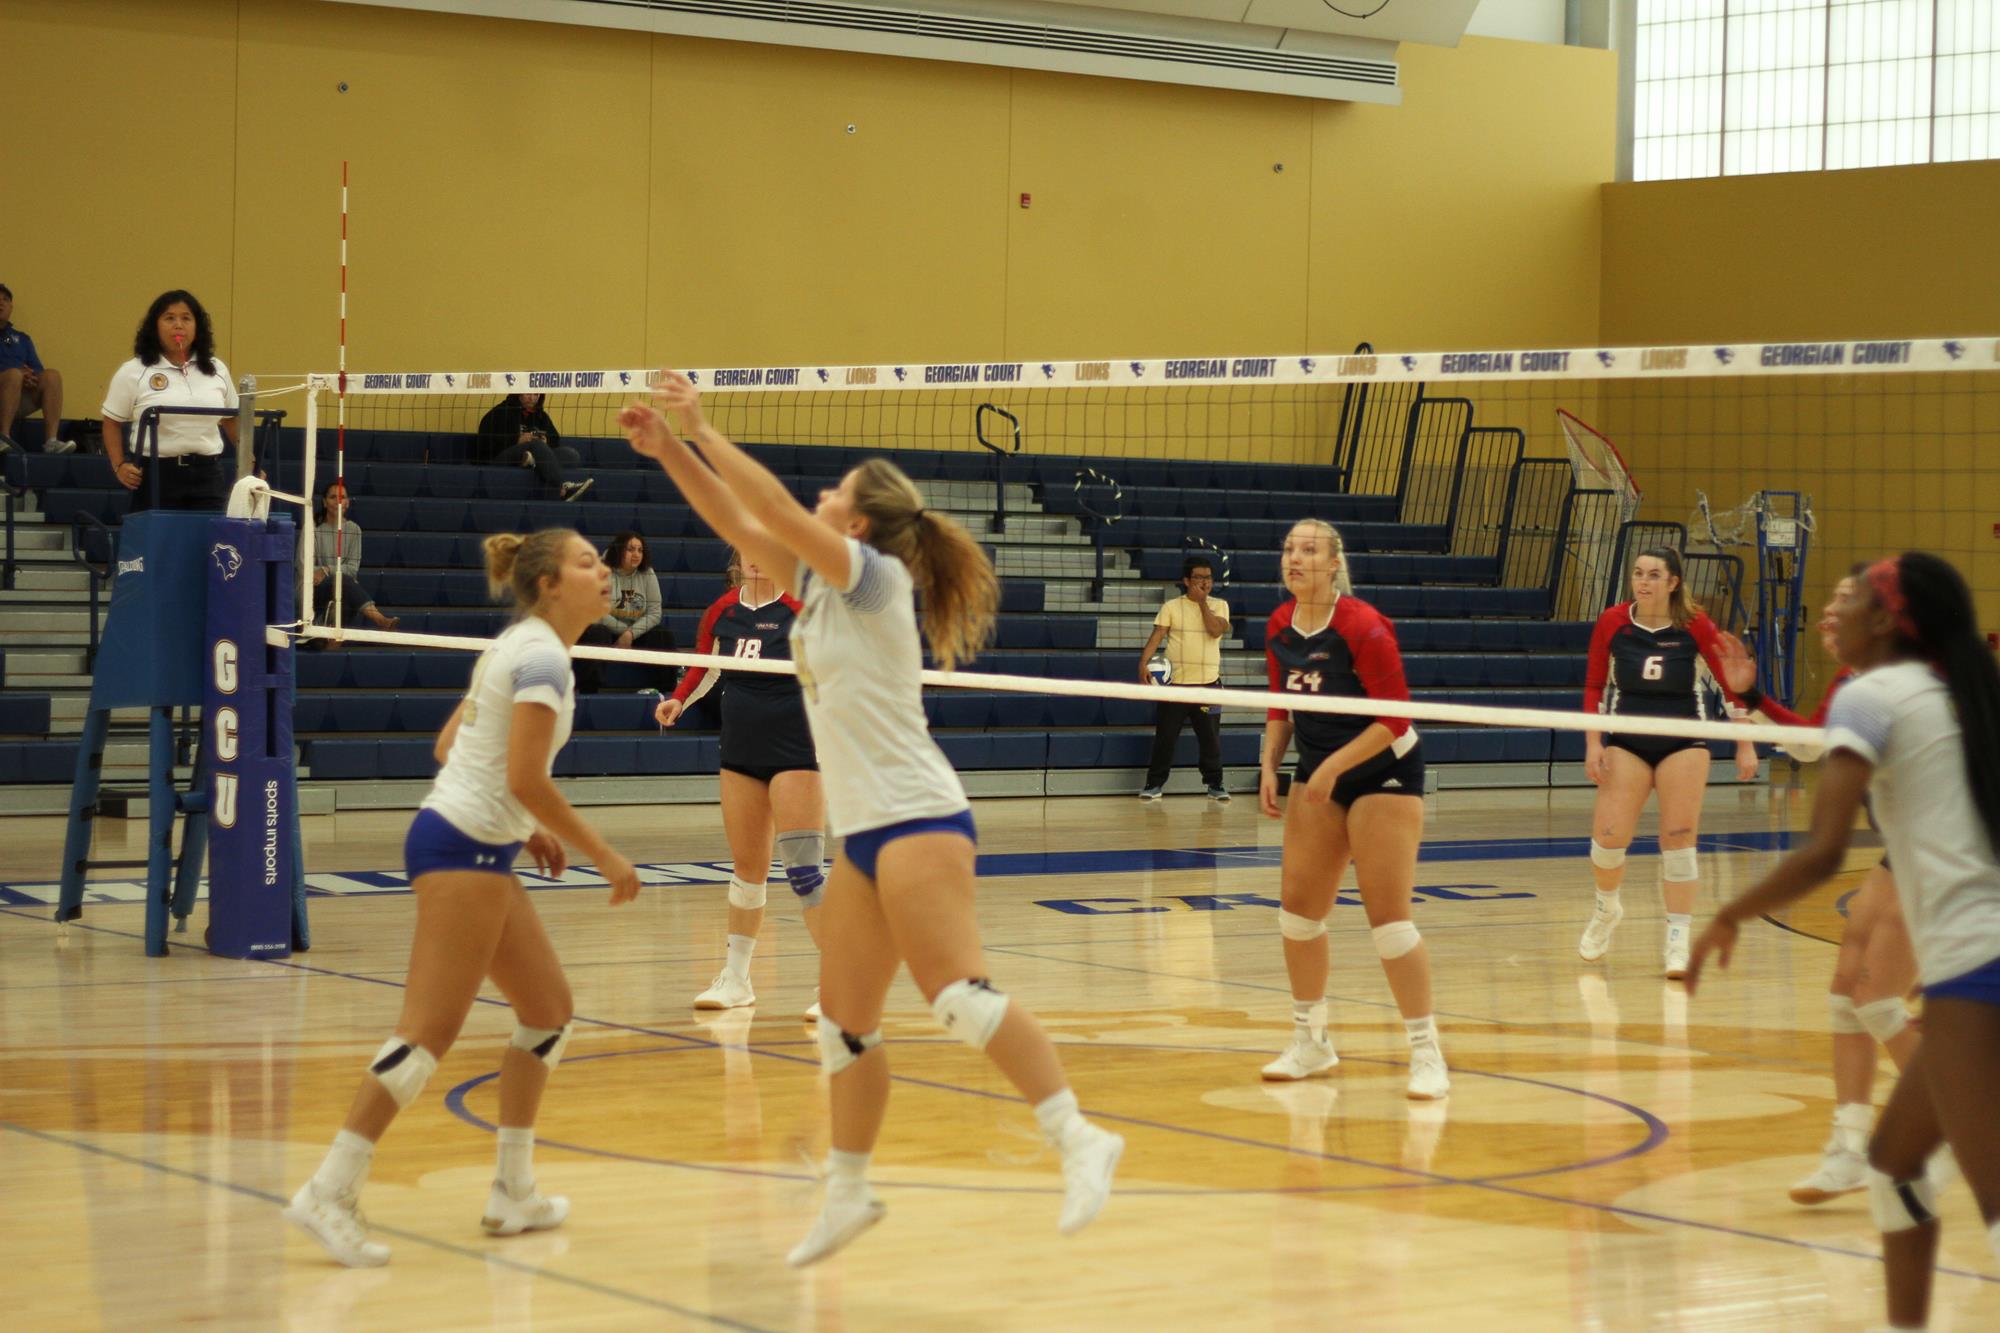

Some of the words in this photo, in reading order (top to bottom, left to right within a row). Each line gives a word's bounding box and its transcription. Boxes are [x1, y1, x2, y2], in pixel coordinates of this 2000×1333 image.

[364, 374, 402, 389] GEORGIAN
[405, 374, 432, 389] COURT
[466, 373, 492, 389] LIONS
[529, 372, 572, 388] GEORGIAN
[575, 372, 605, 388] COURT
[714, 369, 762, 386] GEORGIAN
[765, 368, 800, 385] COURT
[846, 367, 877, 385] LIONS
[925, 365, 979, 383] GEORGIAN
[984, 364, 1023, 382] COURT
[1075, 362, 1110, 381] LIONS
[1165, 360, 1227, 379] GEORGIAN
[1232, 359, 1277, 377] COURT
[1337, 356, 1378, 376] LIONS
[1441, 353, 1513, 373] GEORGIAN
[1520, 351, 1571, 372] COURT
[1641, 349, 1688, 370] LIONS
[1761, 344, 1845, 367] GEORGIAN
[1852, 342, 1912, 364] COURT
[735, 638, 762, 659] 18
[1286, 669, 1322, 692] 24
[1642, 656, 1664, 680] 6
[215, 639, 239, 829] GCU
[265, 780, 279, 826] sports
[264, 828, 278, 885] imports
[1033, 884, 1537, 915] CAC
